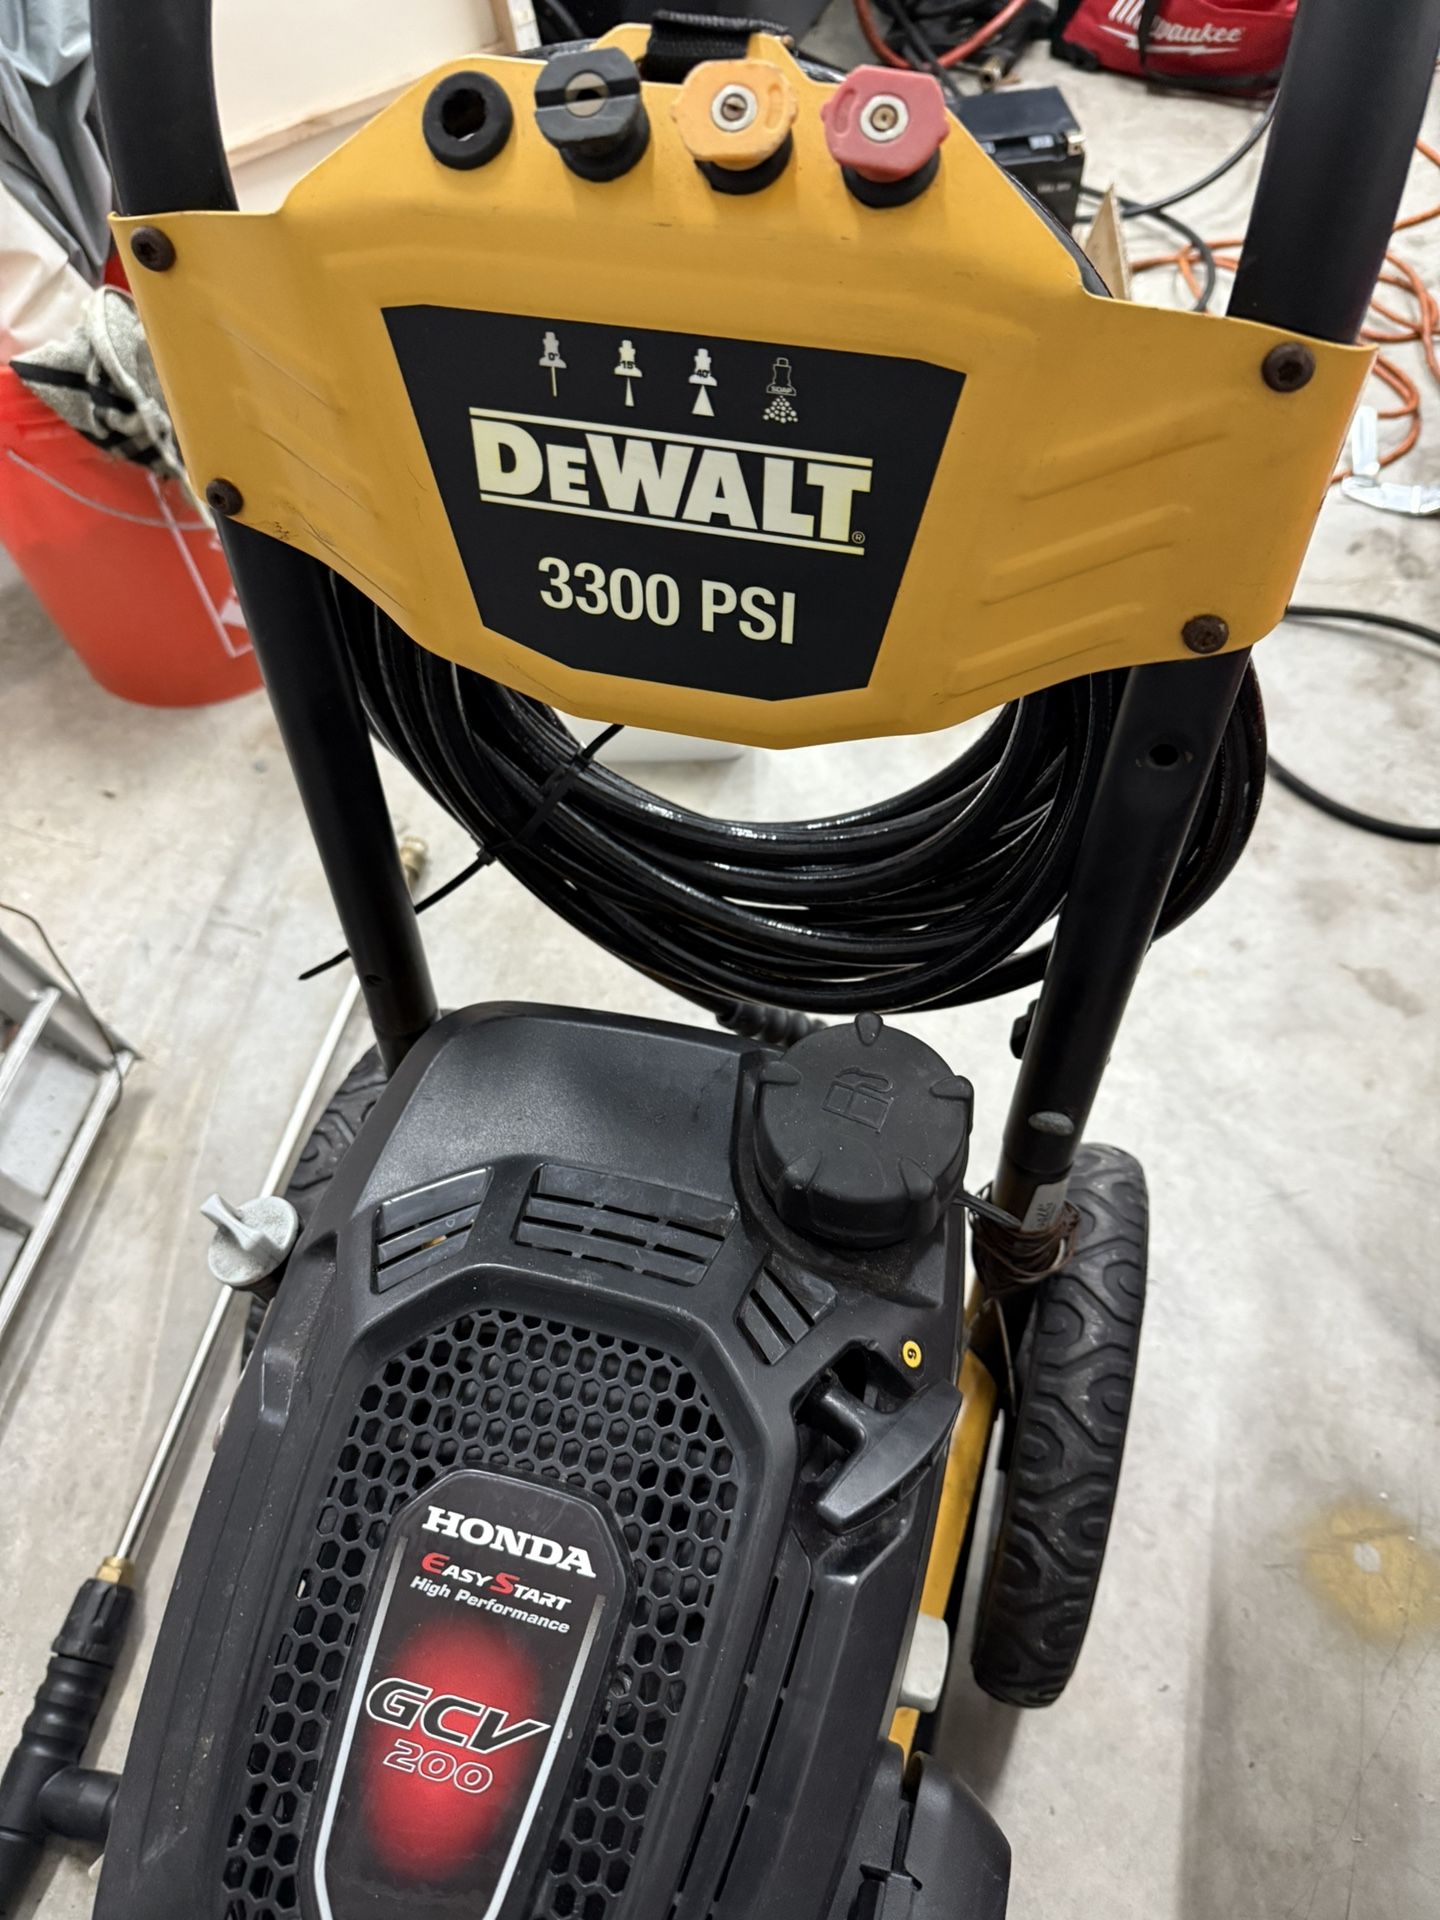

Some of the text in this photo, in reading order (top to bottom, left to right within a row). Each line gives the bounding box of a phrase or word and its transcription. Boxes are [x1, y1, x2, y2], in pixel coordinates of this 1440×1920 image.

[1107, 0, 1242, 43] Mwaukee
[770, 386, 793, 394] SOAP
[538, 556, 796, 645] 3300 PSI
[421, 1505, 597, 1579] HONDA
[410, 1575, 570, 1634] High Performance
[366, 1677, 551, 1754] GCV
[383, 1738, 493, 1794] 200
